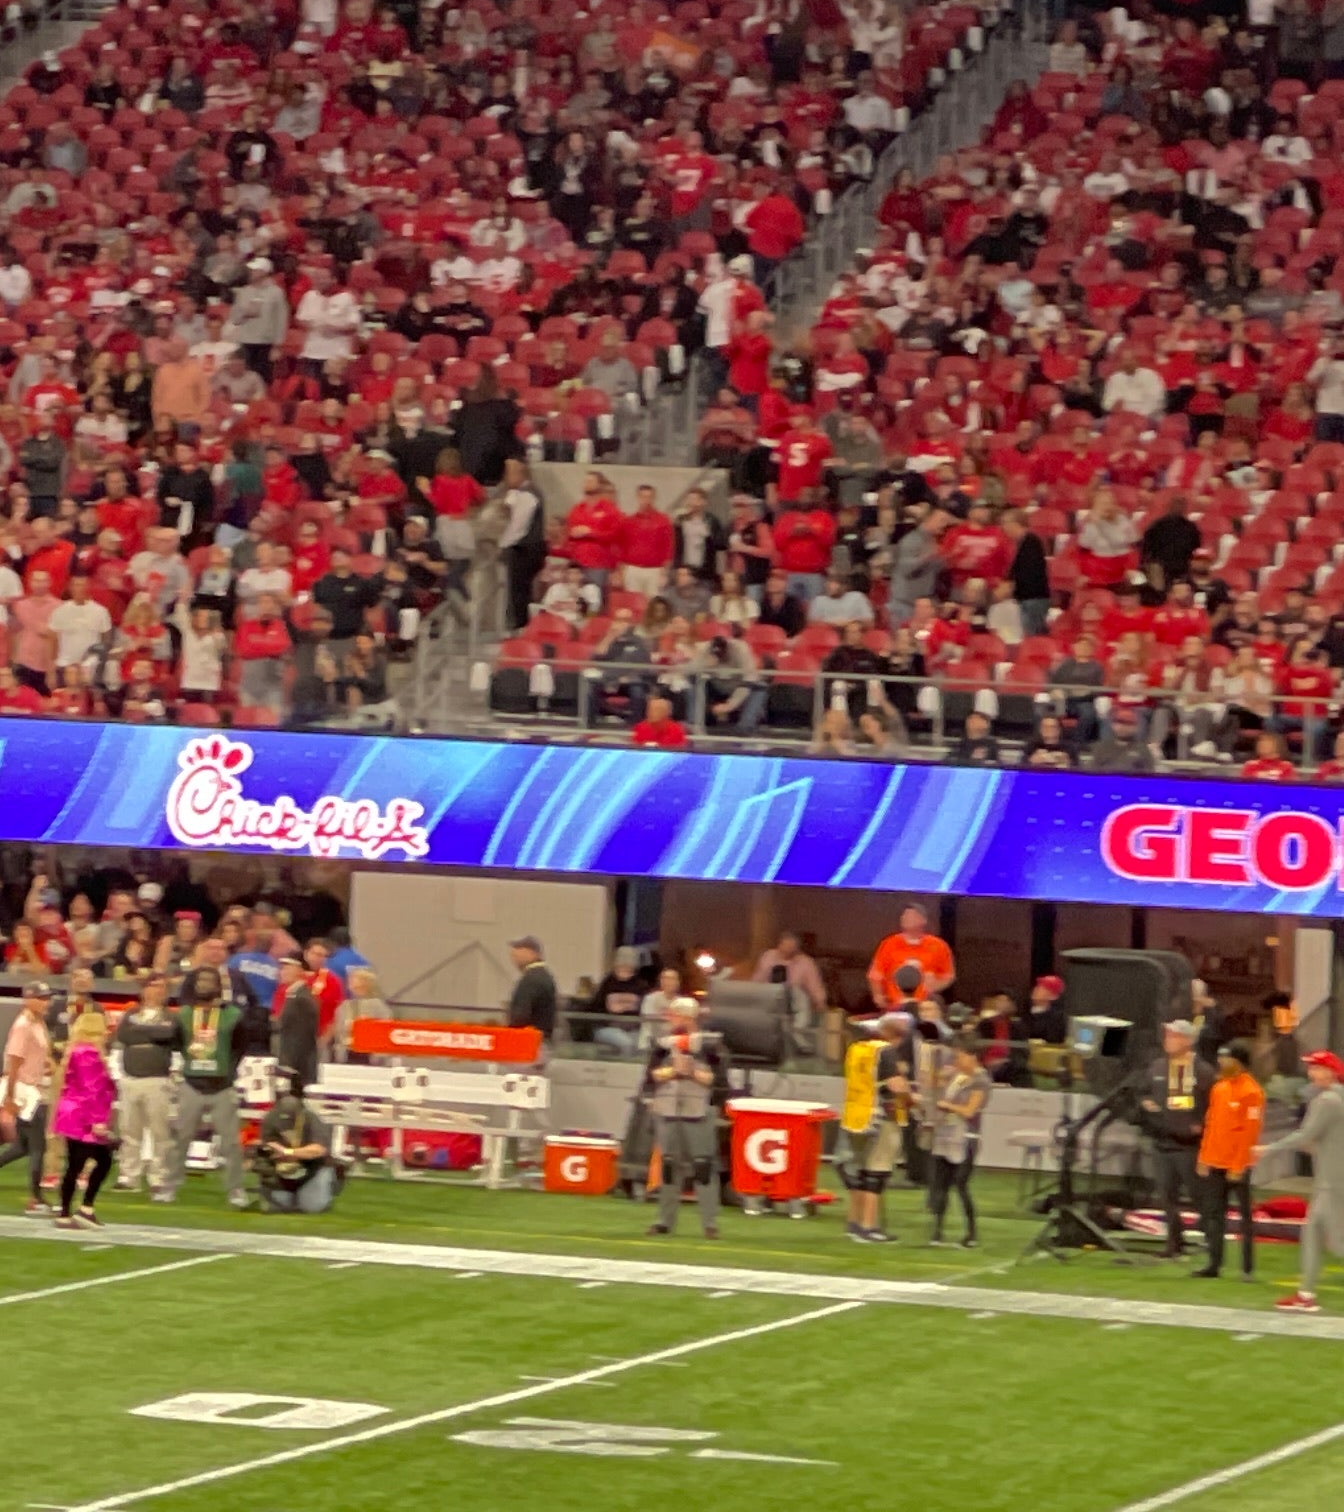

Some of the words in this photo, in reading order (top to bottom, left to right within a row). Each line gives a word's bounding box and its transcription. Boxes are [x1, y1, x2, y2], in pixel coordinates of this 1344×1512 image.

[787, 442, 810, 467] 5
[1100, 802, 1344, 893] GEO
[559, 1155, 590, 1182] G
[743, 1128, 789, 1174] G
